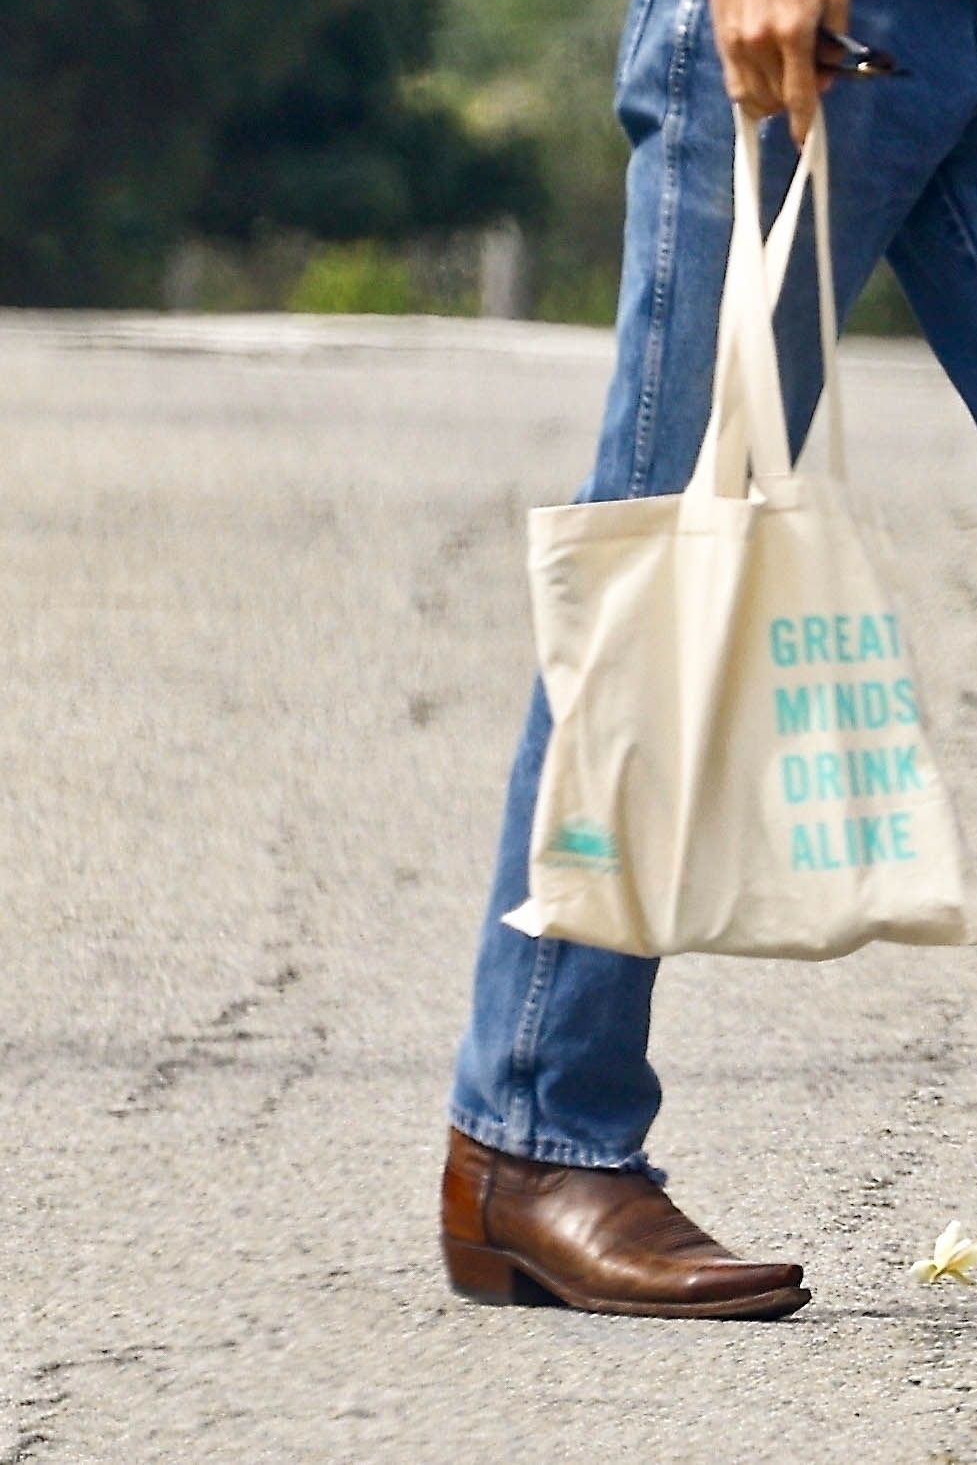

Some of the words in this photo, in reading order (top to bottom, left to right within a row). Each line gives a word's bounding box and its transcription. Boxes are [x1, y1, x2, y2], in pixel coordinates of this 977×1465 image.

[770, 613, 902, 667] GREAT
[775, 677, 919, 736] MINDS
[782, 745, 923, 804] DRINK
[791, 812, 917, 871] ALIKE
